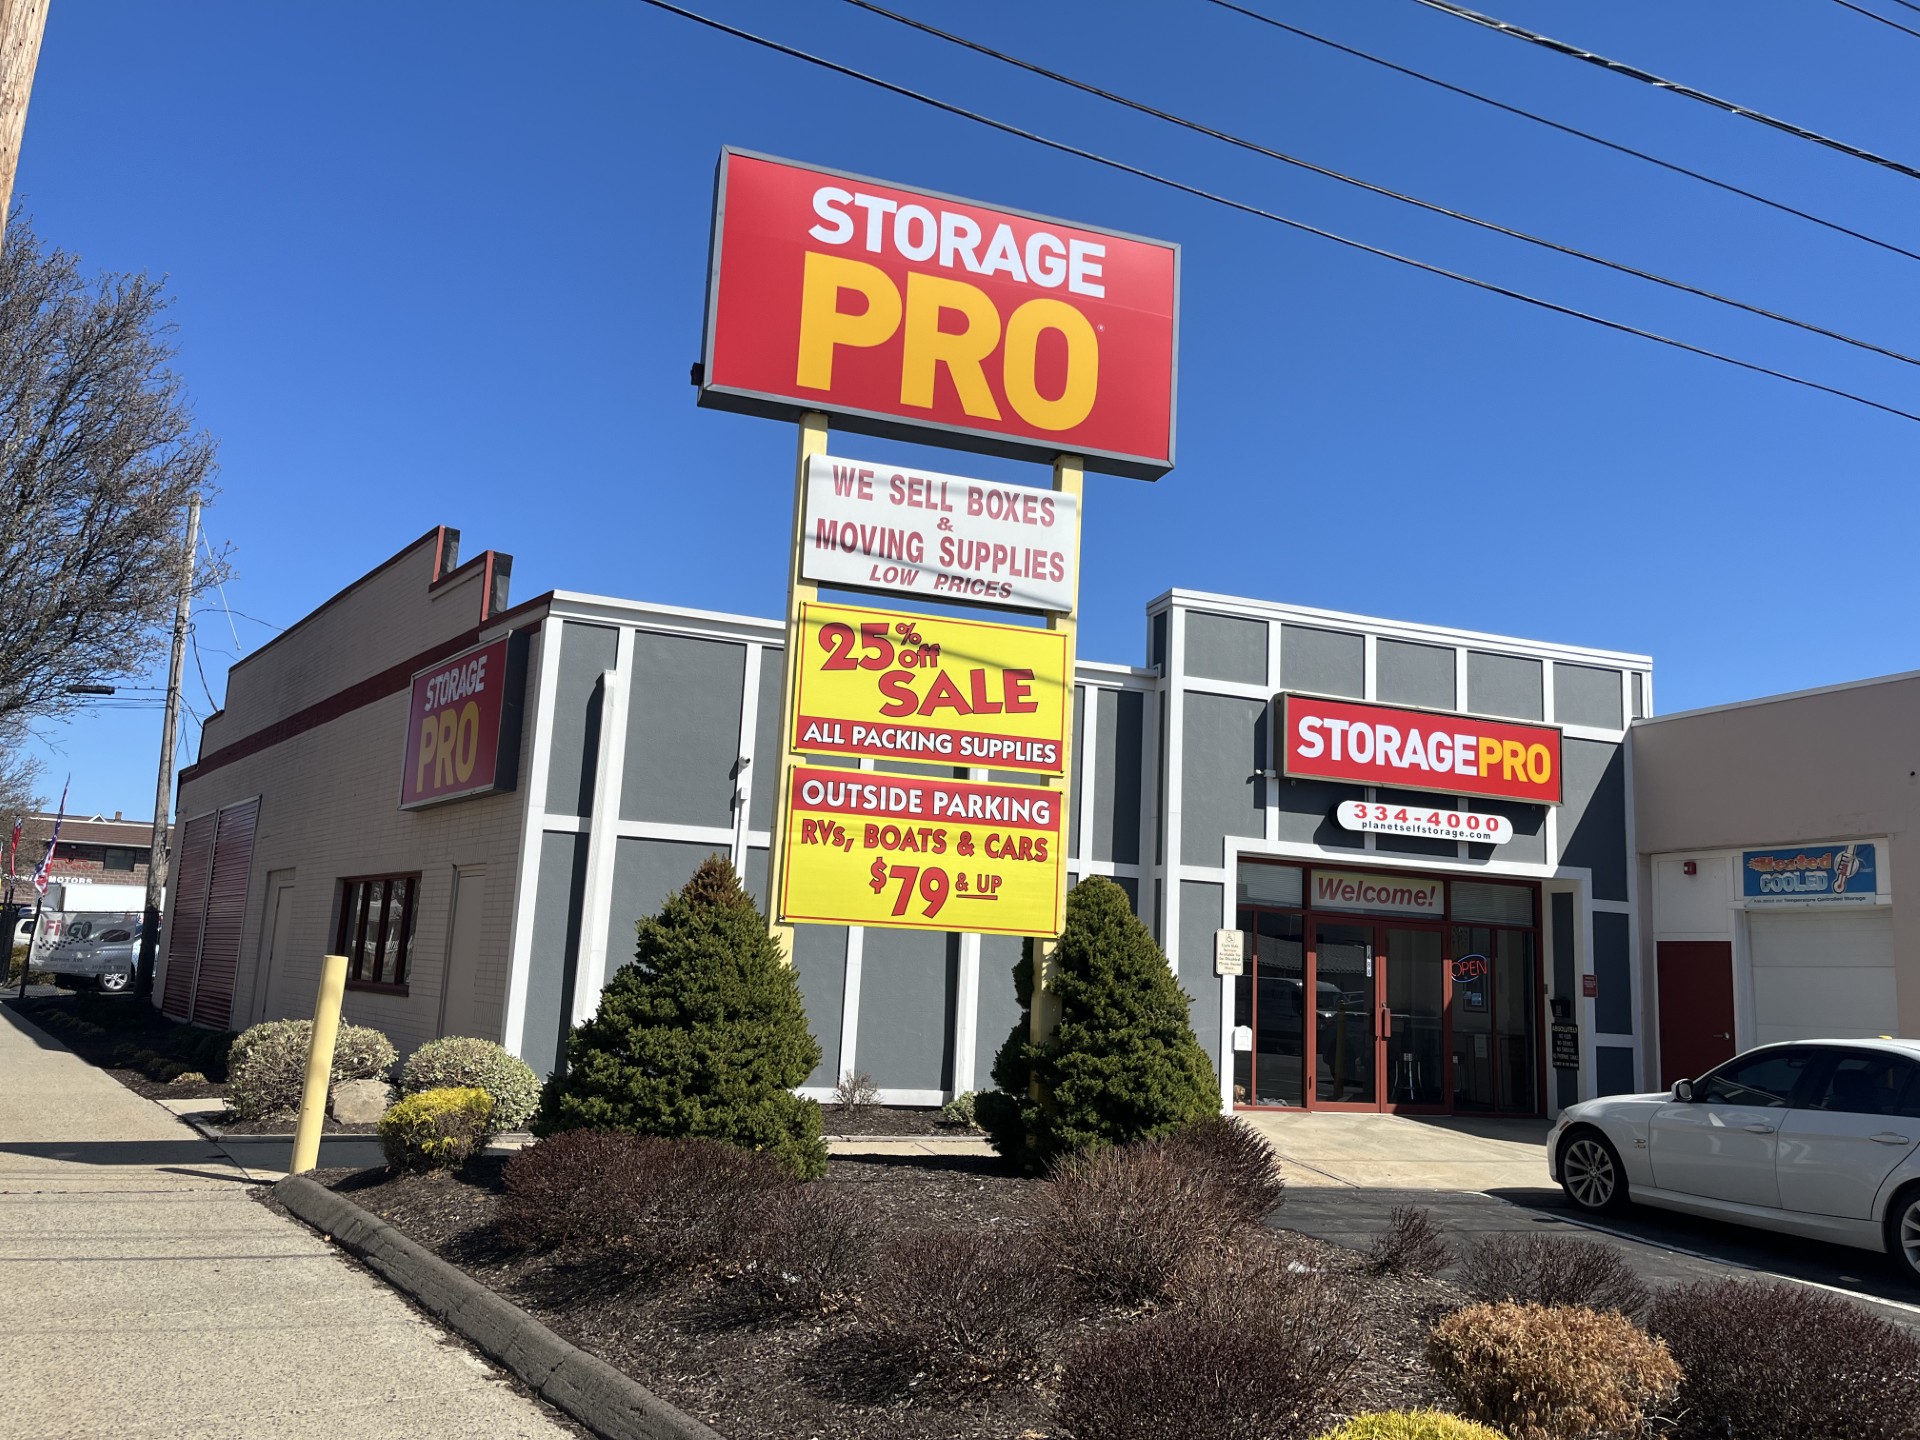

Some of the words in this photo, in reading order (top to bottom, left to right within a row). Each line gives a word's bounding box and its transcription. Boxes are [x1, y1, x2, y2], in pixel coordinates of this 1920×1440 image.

[808, 186, 1106, 298] STORAGE
[796, 250, 1099, 431] PRO
[832, 464, 875, 501] WE
[889, 474, 953, 513] SELL
[967, 486, 1055, 527] BOXES
[937, 517, 953, 532] &
[815, 517, 924, 564] MOVING
[939, 536, 1065, 583] SUPPLIES
[869, 564, 919, 587] LOW
[933, 573, 1013, 599] PRICES
[898, 643, 940, 668] off
[424, 654, 488, 711] STORAGE
[878, 669, 1039, 717] SALE
[416, 701, 480, 793] PRO
[802, 721, 845, 744] ALL
[852, 725, 952, 754] PACKING
[959, 736, 1056, 763] SUPPLIES
[801, 779, 923, 814] OUTSIDE
[933, 791, 1050, 825] PARKING
[1353, 803, 1499, 832] 334-4000
[864, 823, 947, 854] BOATS
[957, 830, 975, 857] &
[984, 833, 1048, 862] CARS
[1361, 820, 1491, 841] planetselfstorage.com
[48, 875, 92, 884] MOTORS
[869, 856, 950, 918] $79
[955, 872, 968, 891] &
[977, 874, 1003, 893] UP
[1318, 877, 1436, 907] Welcome!
[1760, 872, 1828, 893] COOLED
[1451, 960, 1488, 976] OPEN
